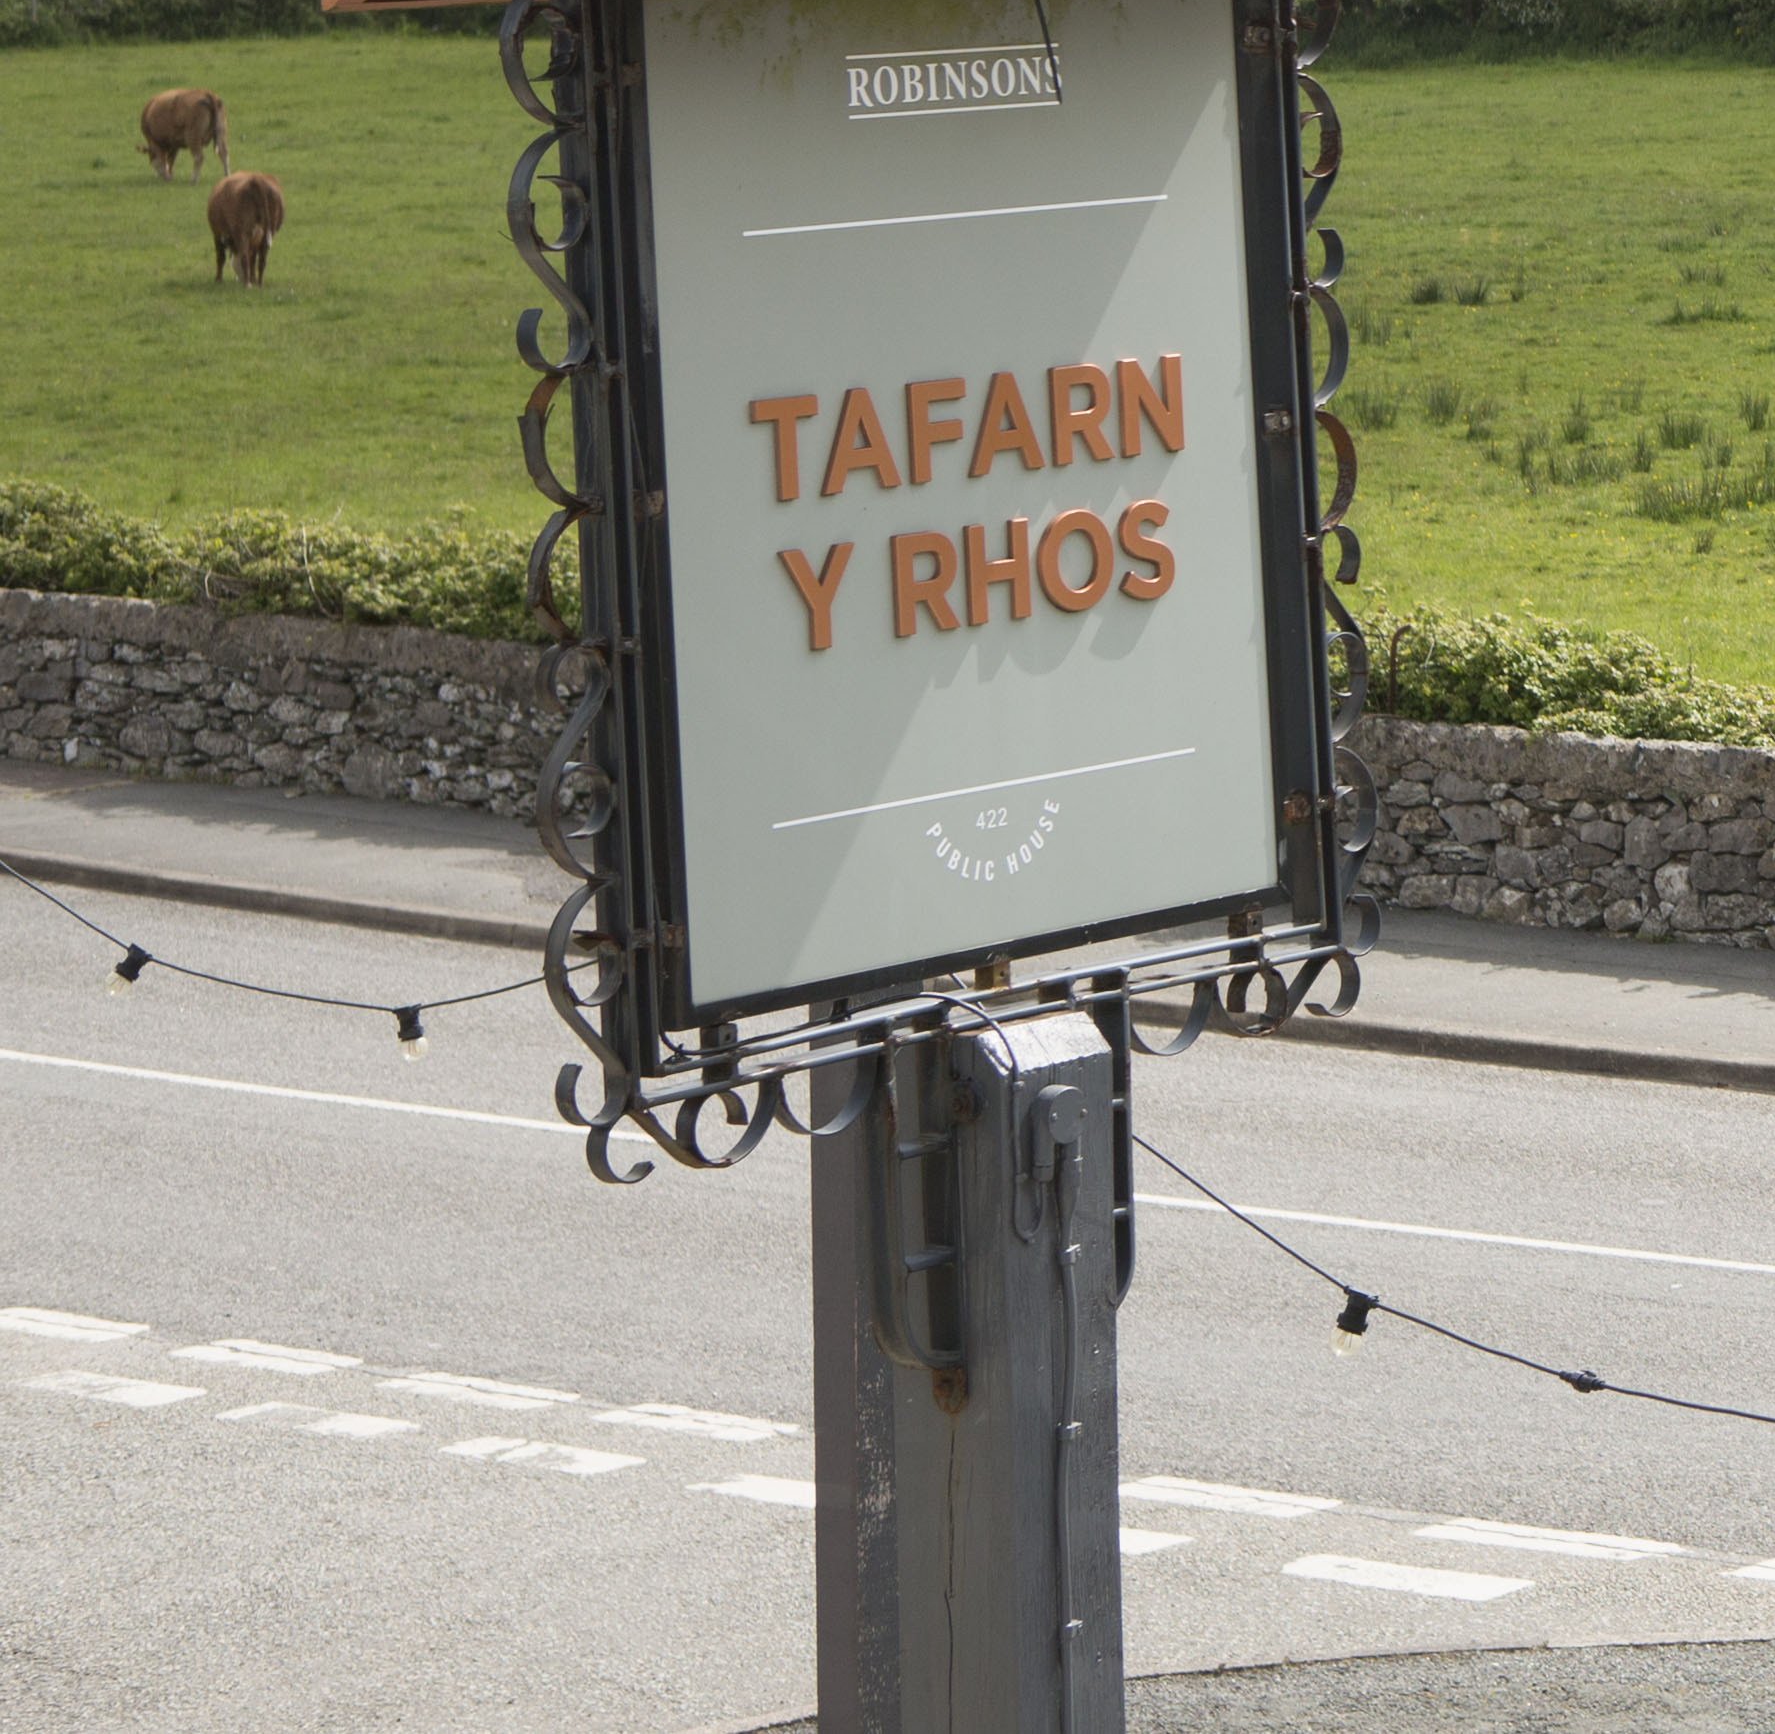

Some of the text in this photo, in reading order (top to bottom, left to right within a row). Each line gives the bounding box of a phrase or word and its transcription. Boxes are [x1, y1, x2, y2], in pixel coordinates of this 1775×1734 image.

[846, 54, 1063, 109] ROBINSONS
[749, 353, 1186, 502] TAFARN
[778, 500, 1176, 651] Y RHOS
[926, 799, 1060, 882] PUBLIC HOUSE
[975, 807, 1008, 830] 422
